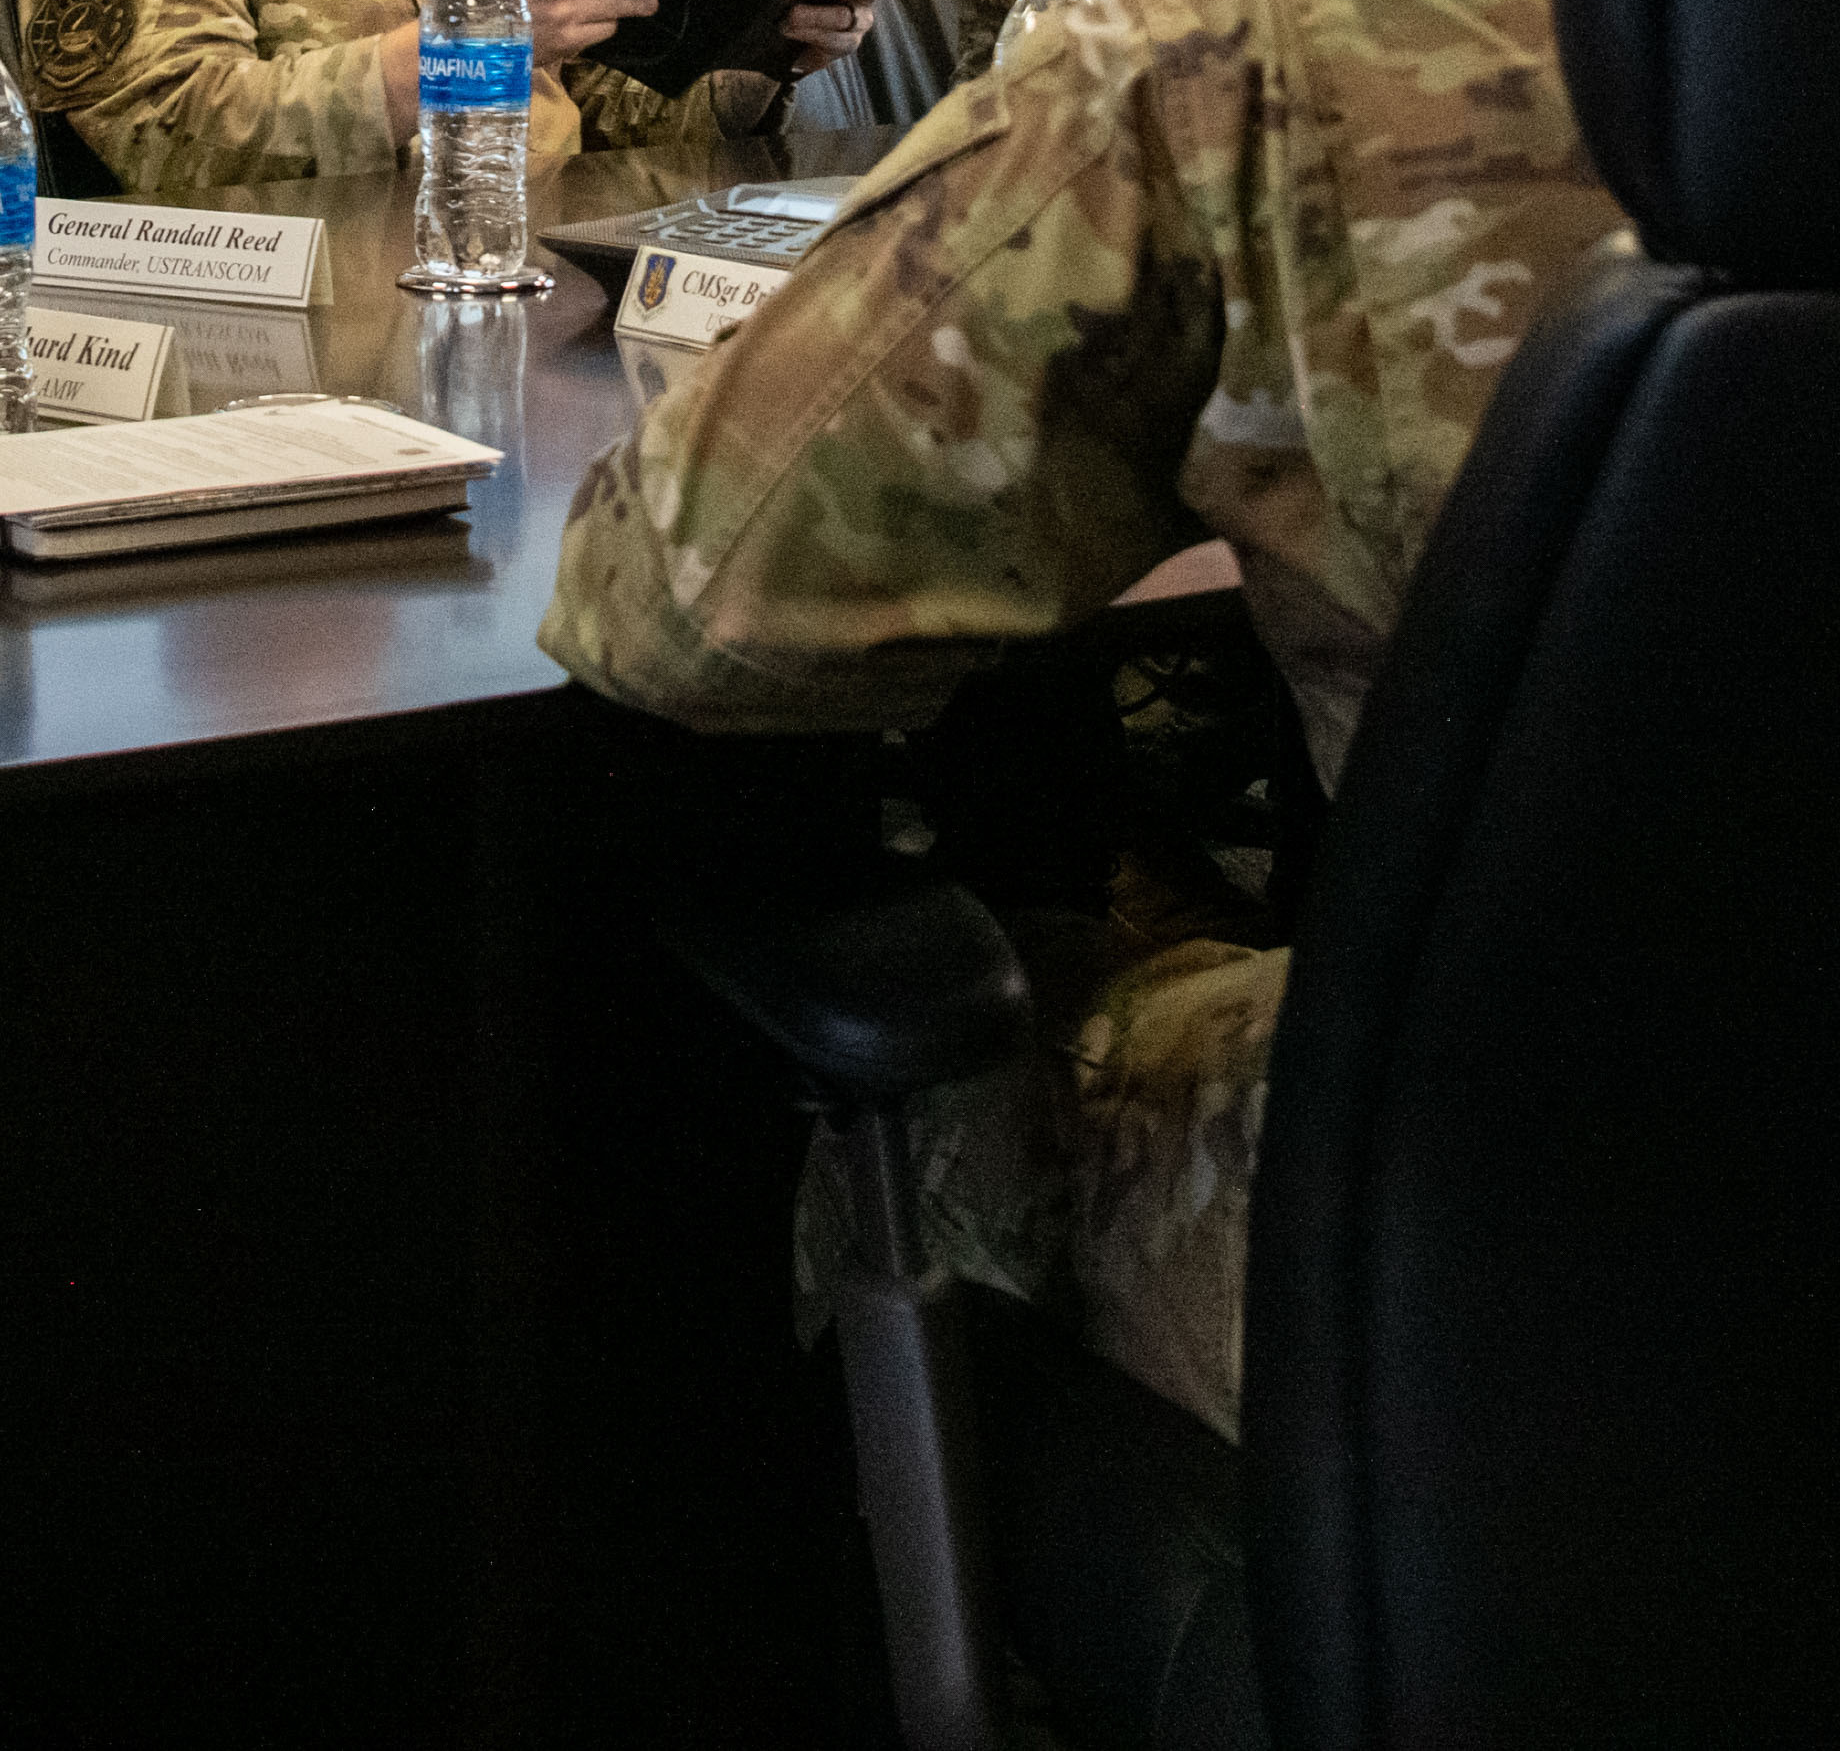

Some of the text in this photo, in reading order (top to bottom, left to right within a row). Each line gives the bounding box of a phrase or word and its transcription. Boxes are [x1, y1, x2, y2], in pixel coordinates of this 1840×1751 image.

[420, 56, 486, 81] QUAFINA
[48, 212, 283, 252] General Randall Reed
[47, 247, 272, 283] Commander, USTRANSCOM
[682, 270, 740, 307] CMSgt
[25, 327, 78, 361] hard
[76, 335, 140, 372] Kind
[40, 378, 84, 400] AMW
